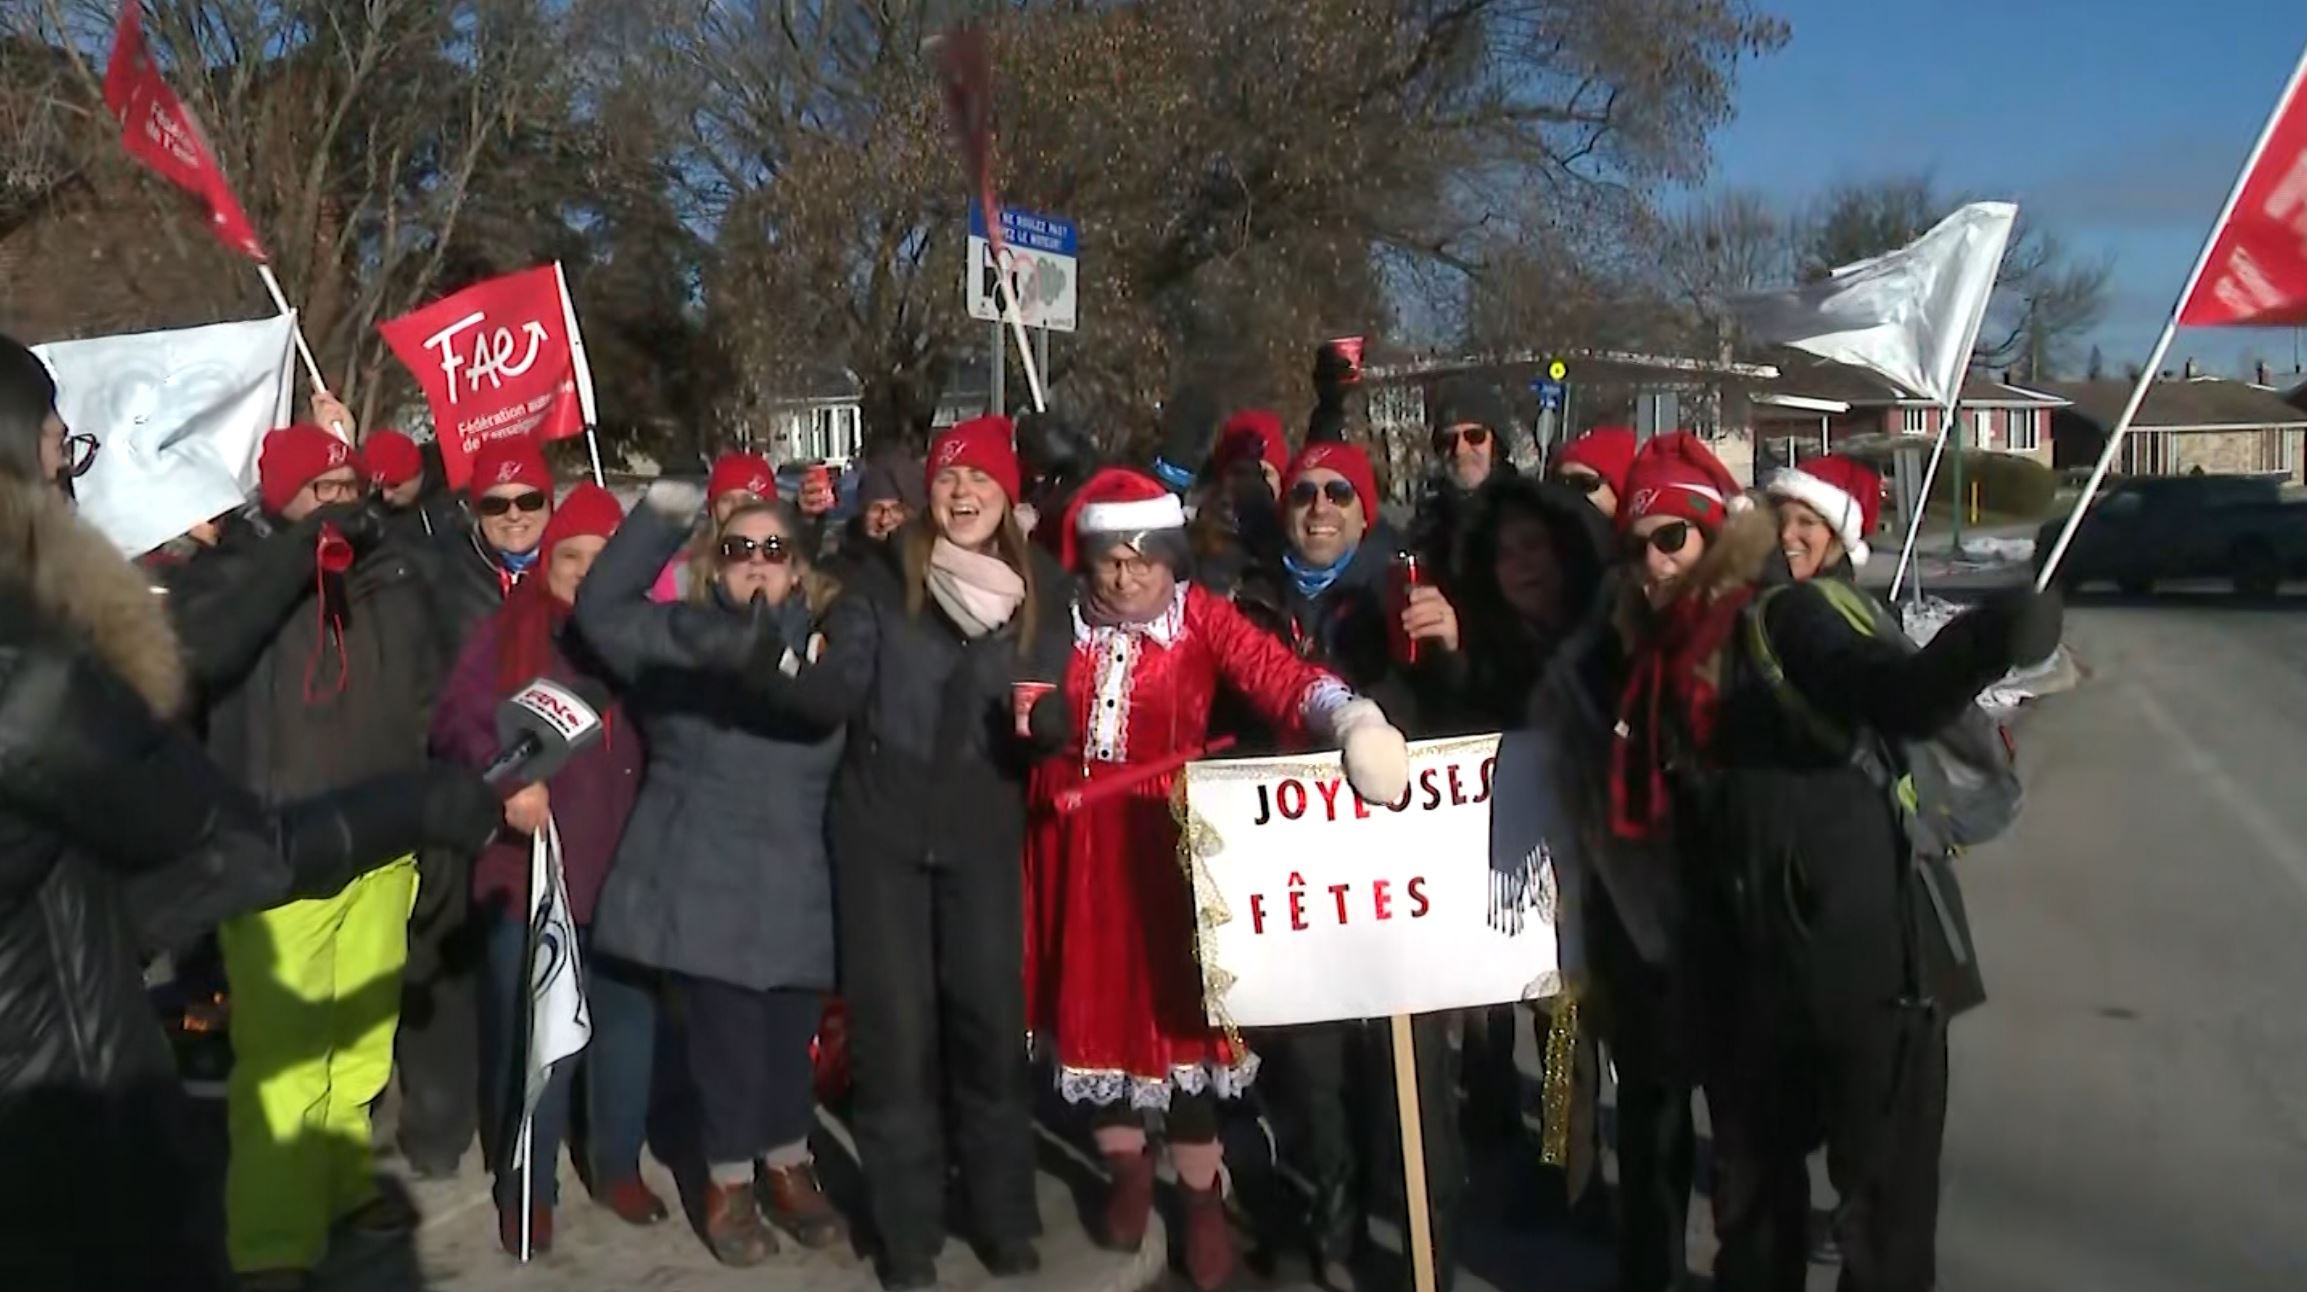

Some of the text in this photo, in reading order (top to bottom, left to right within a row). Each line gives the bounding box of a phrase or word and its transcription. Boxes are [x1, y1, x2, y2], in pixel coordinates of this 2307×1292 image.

[458, 403, 527, 438] Fédération
[462, 436, 481, 453] de
[1250, 871, 1430, 935] FÊTES
